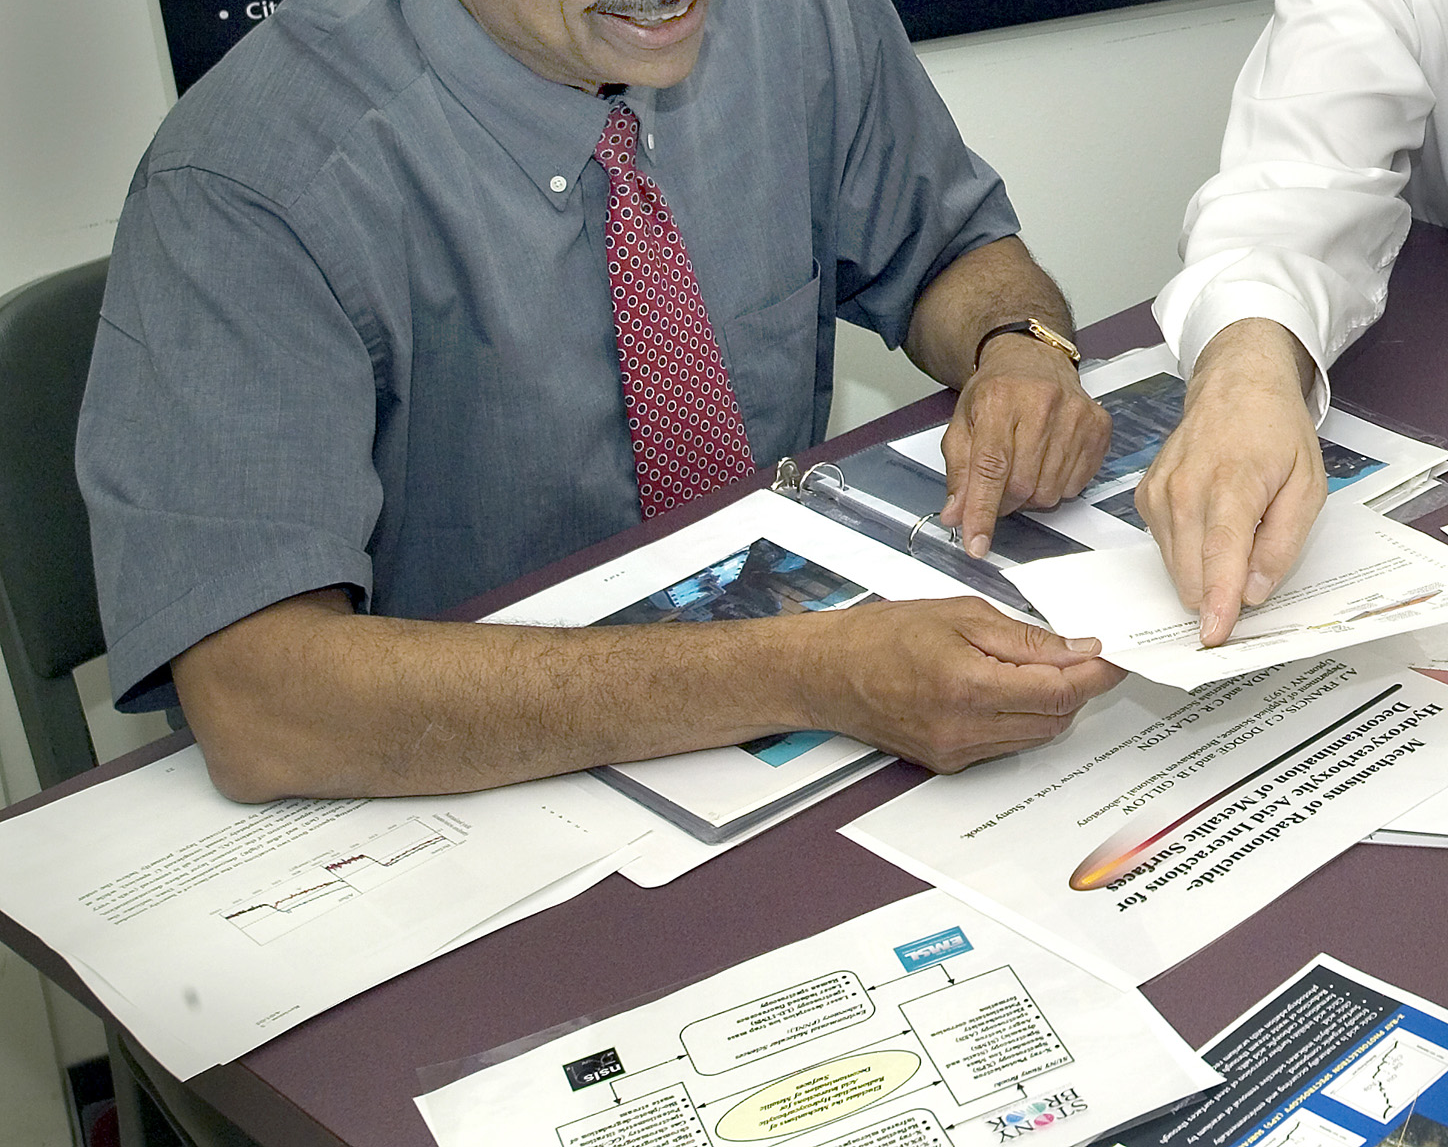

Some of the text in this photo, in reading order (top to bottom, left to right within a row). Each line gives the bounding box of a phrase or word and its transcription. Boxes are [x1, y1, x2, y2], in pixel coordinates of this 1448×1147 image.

[1106, 701, 1412, 892] Decontamination of Metallic Surfaces
[1117, 703, 1444, 912] Hydroxycarboxylic Acid Interactions for
[1186, 737, 1427, 892] Mechanisms of Radionuclide-
